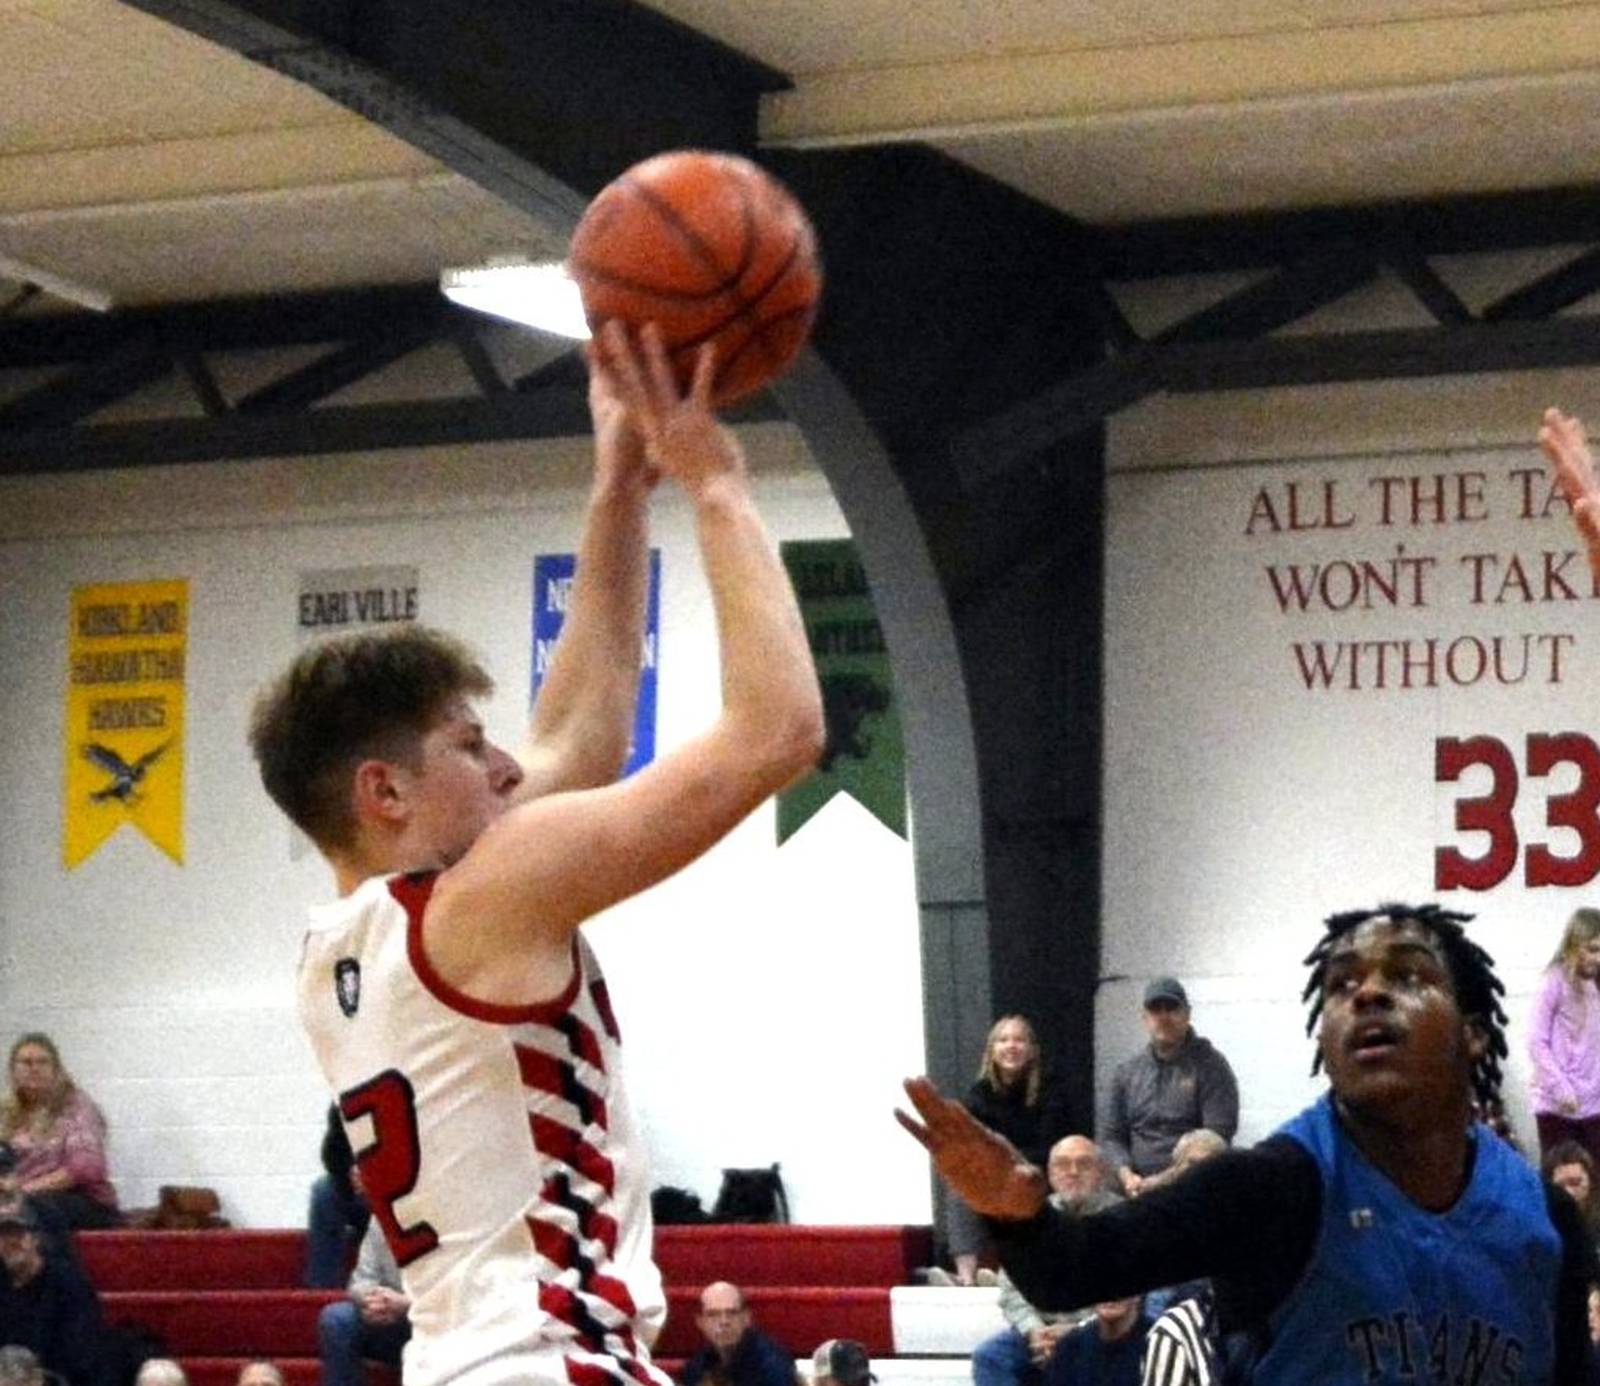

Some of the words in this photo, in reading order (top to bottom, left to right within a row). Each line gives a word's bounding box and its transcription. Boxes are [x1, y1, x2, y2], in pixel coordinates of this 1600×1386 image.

[1244, 482, 1356, 534] ALL
[1369, 472, 1489, 526] THE
[1509, 468, 1582, 520] TA
[1460, 551, 1600, 605] TAK
[1293, 633, 1574, 690] WITHOUT
[1435, 731, 1600, 892] 33
[338, 1068, 440, 1269] 2
